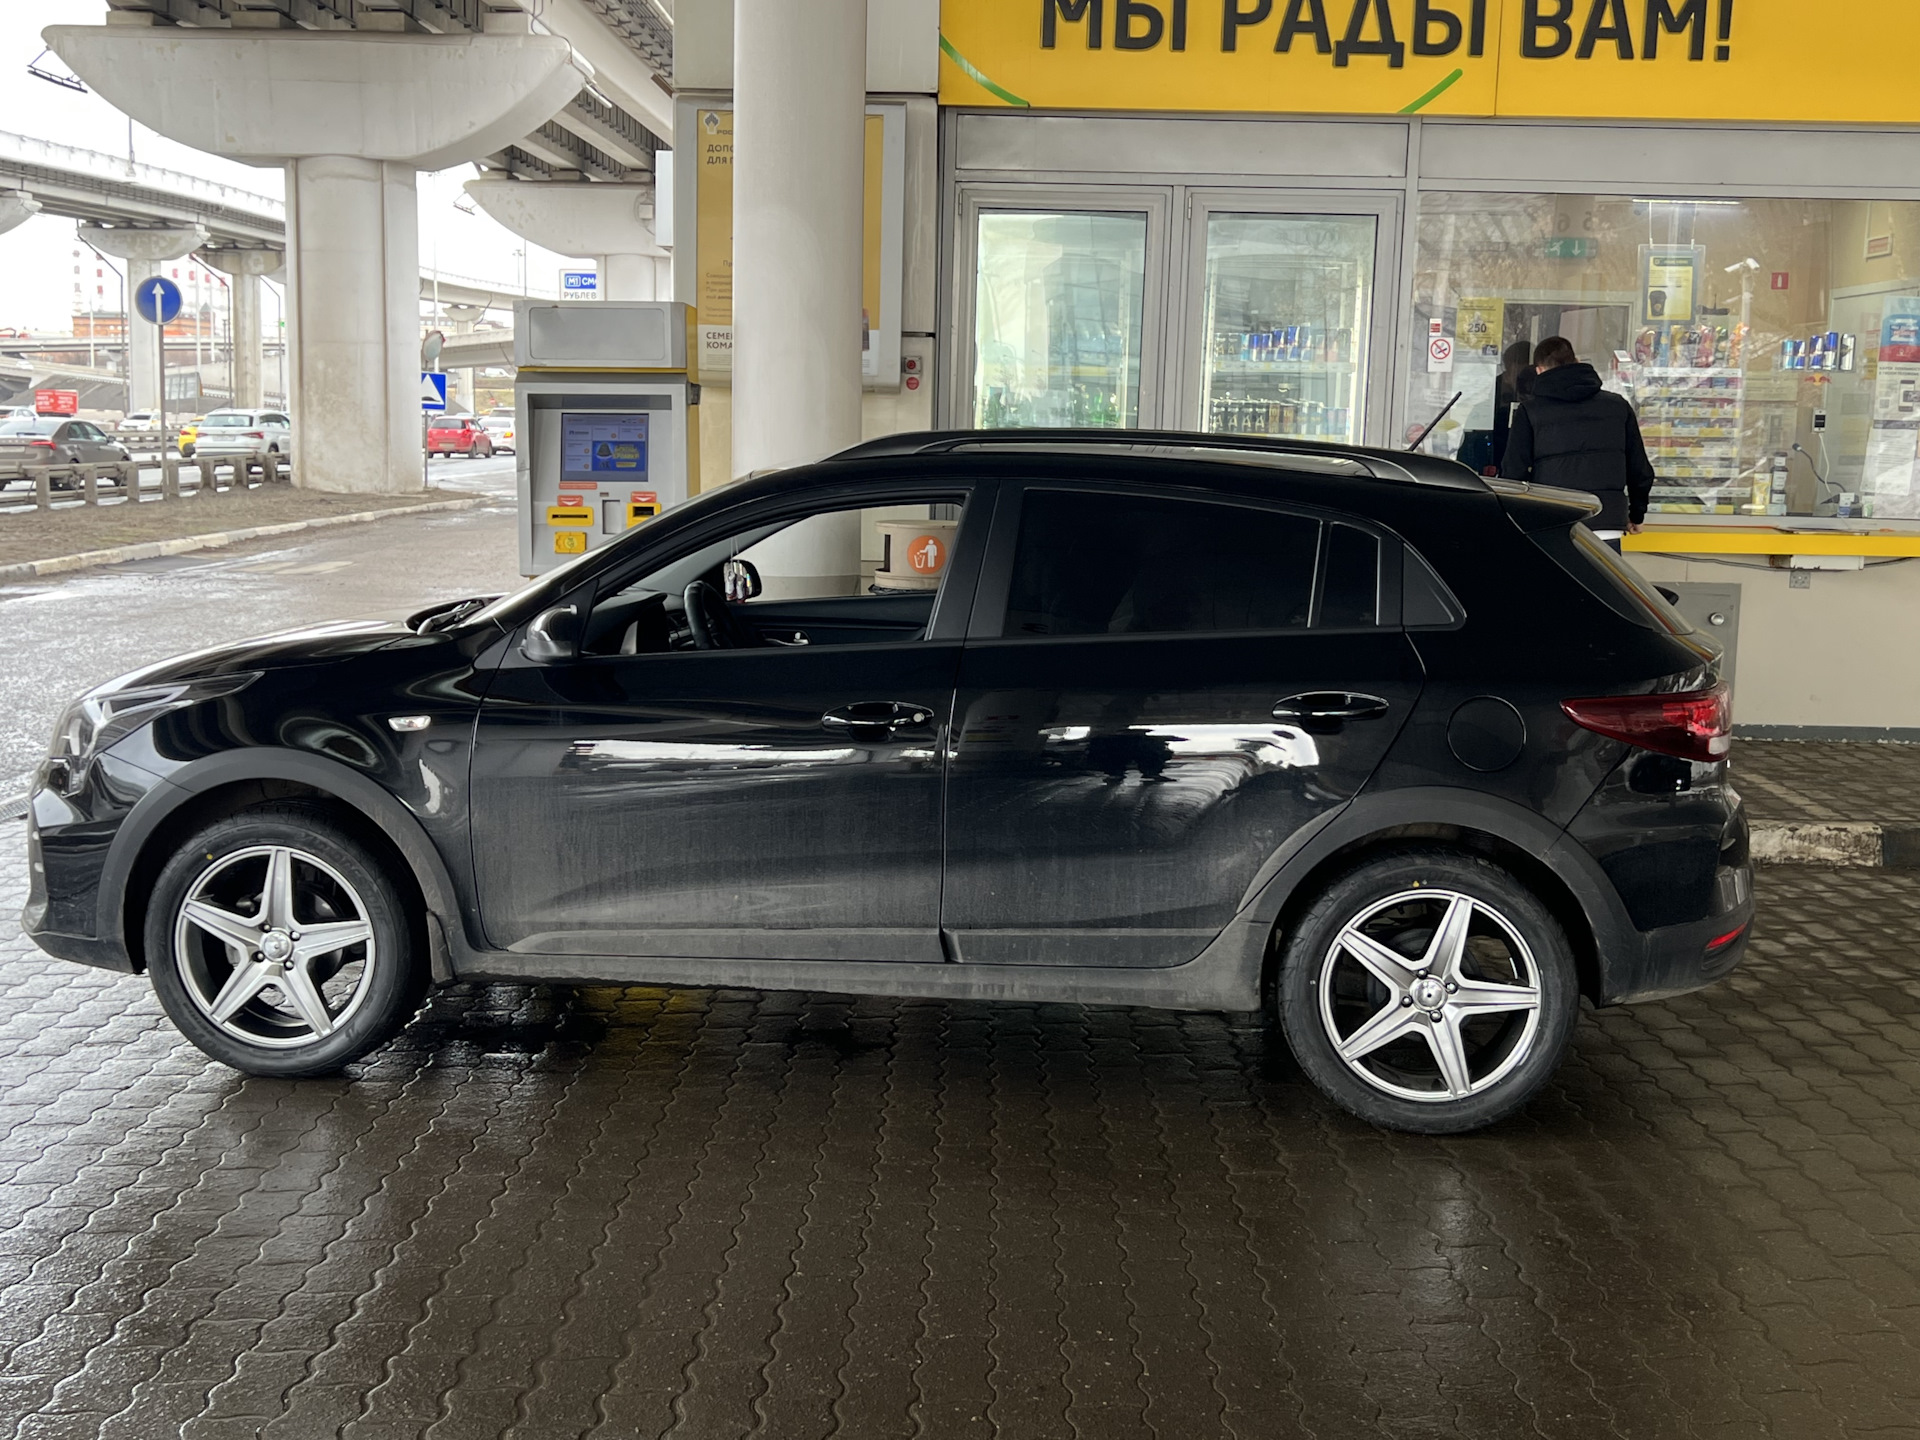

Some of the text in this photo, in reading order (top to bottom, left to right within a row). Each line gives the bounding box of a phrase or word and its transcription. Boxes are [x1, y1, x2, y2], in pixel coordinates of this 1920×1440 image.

[1041, 0, 1735, 68] МЫ РАДЫ ВАМ!
[706, 156, 728, 165] ДЛЯ
[582, 277, 597, 285] СМ
[1467, 323, 1487, 333] 250
